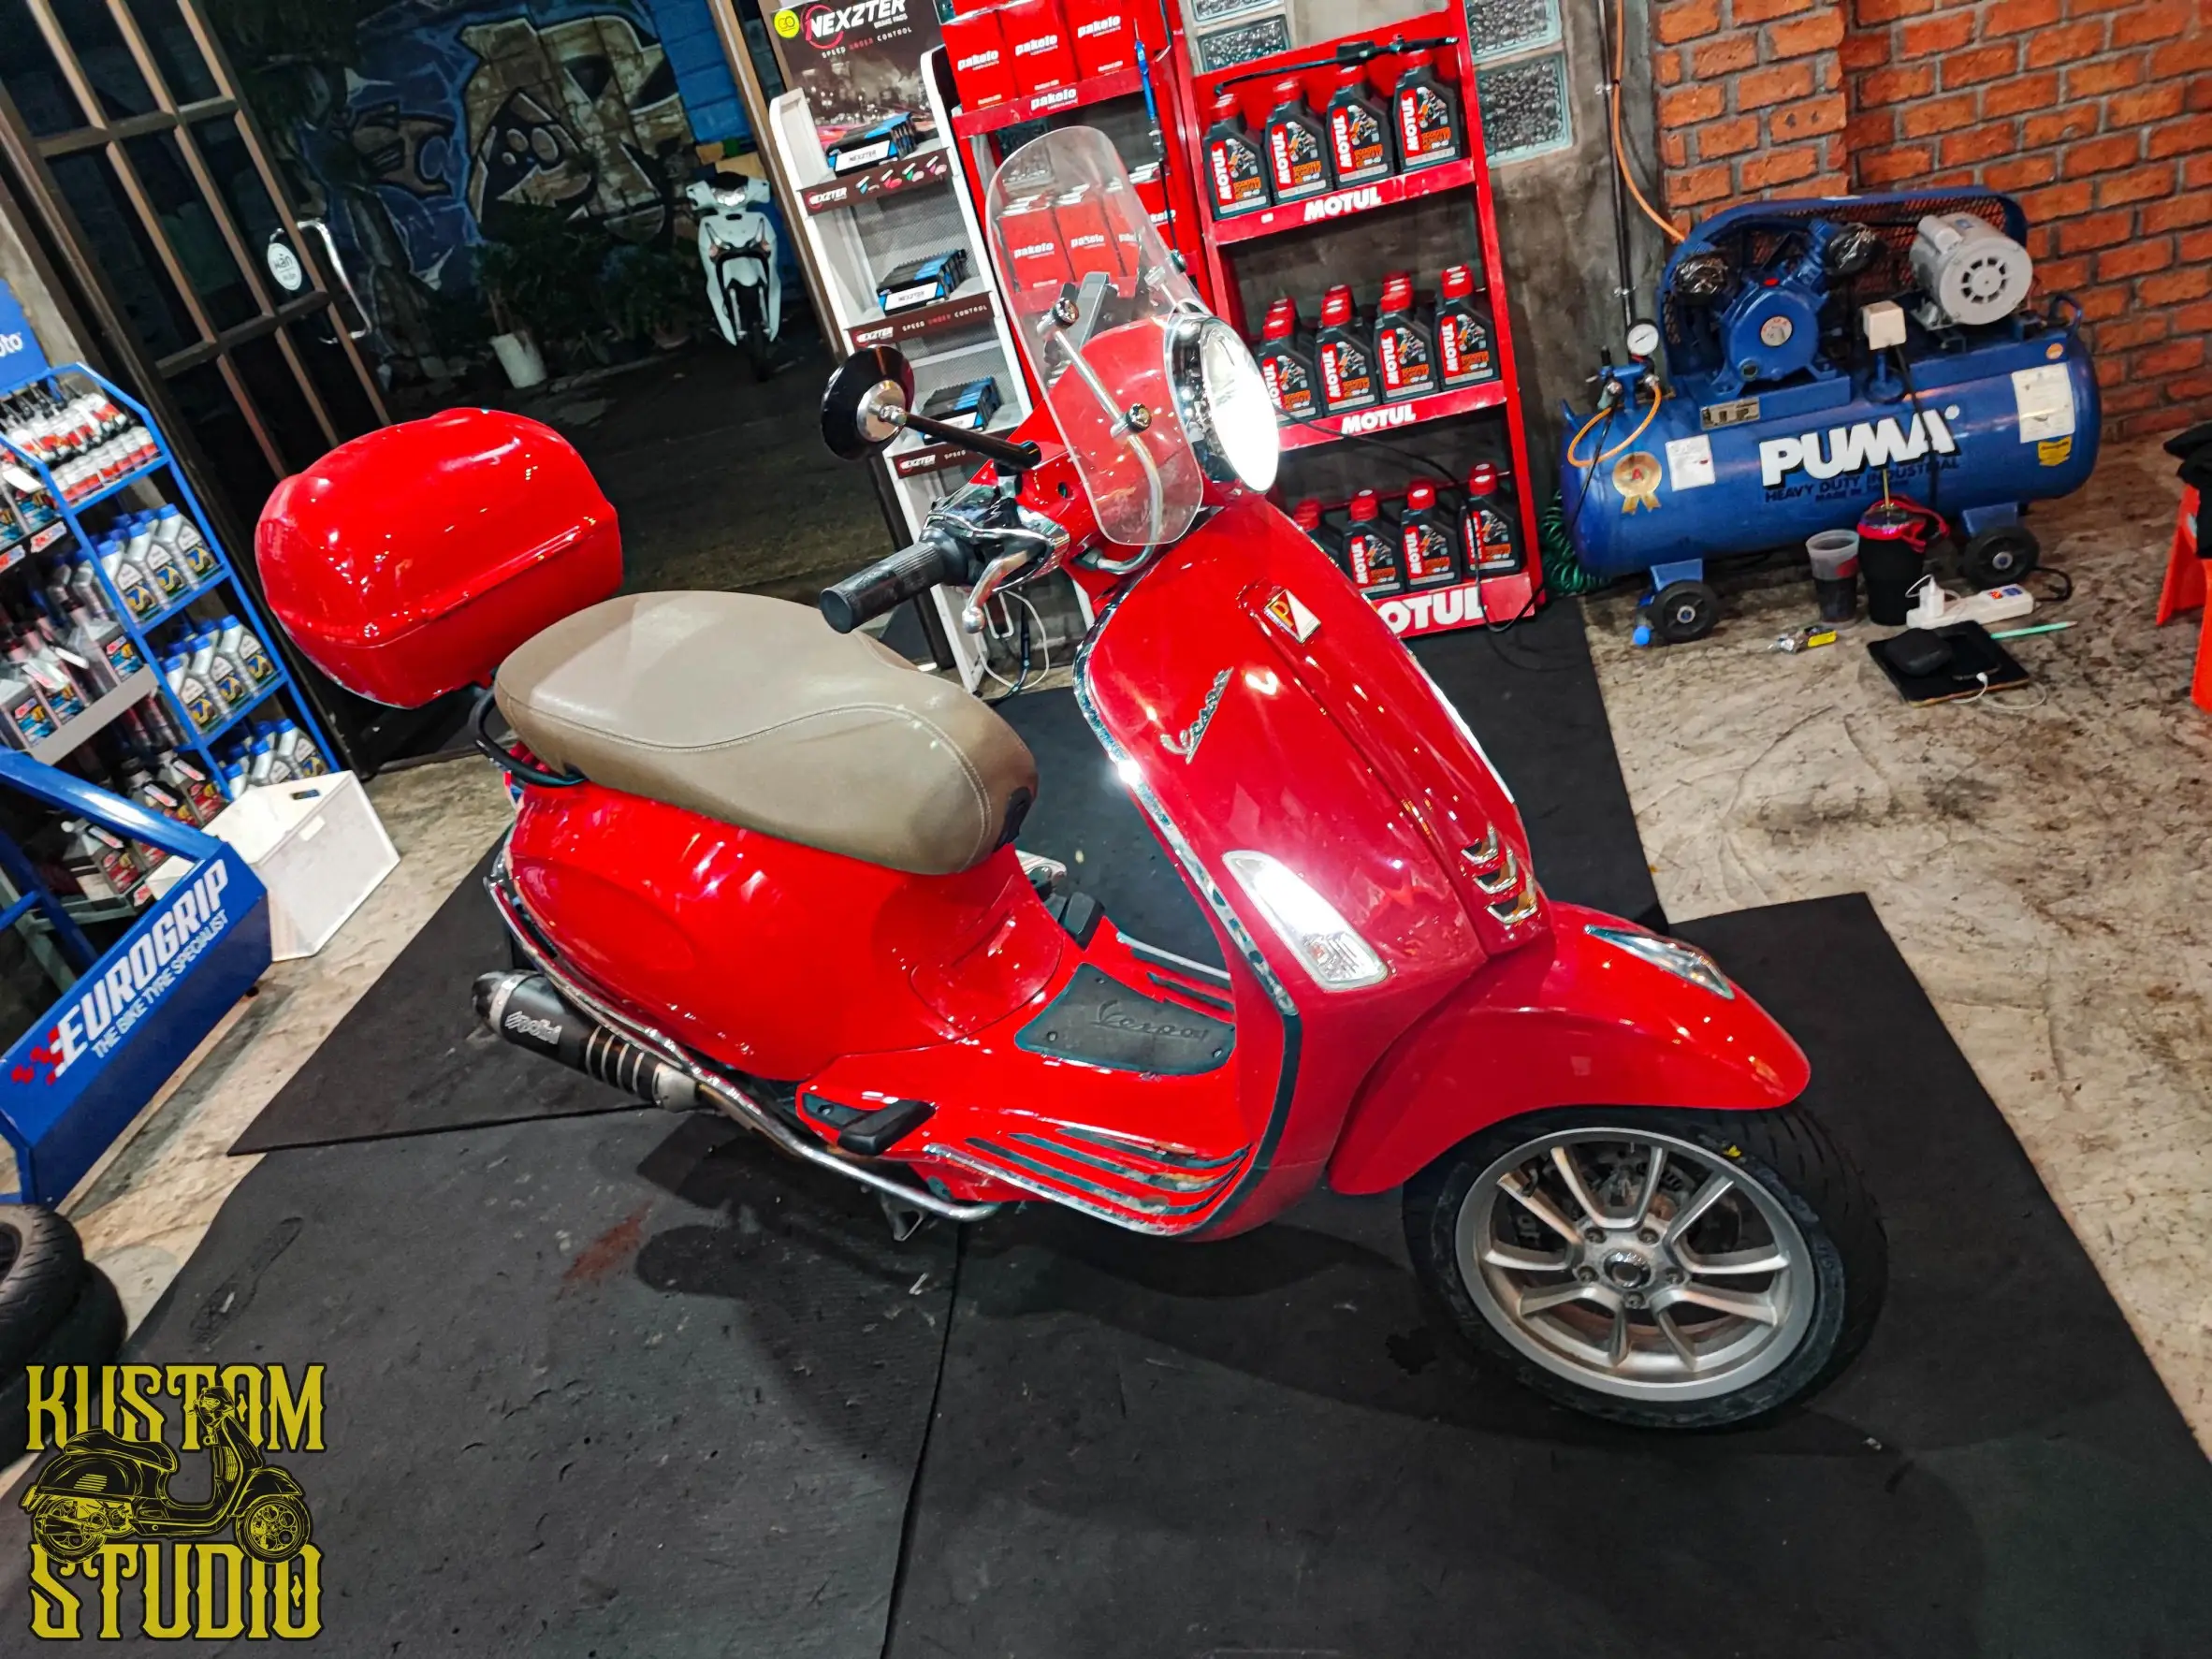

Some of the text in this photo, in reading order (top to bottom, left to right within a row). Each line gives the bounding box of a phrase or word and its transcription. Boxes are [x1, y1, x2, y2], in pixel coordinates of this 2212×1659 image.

[809, 0, 907, 37] NEXZTER
[1078, 15, 1121, 37] pakelo
[822, 46, 847, 59] SPEED
[877, 26, 912, 42] CONTROL
[957, 50, 999, 71] pakelo
[1015, 35, 1058, 56] pakelo
[1030, 88, 1077, 111] pakelo
[1332, 114, 1353, 167] MOTUL
[1401, 96, 1420, 151] MOTUL
[1211, 148, 1233, 200] MOTUL
[1271, 131, 1292, 184] MOTUL
[1303, 186, 1382, 222] MOTUL
[1013, 242, 1055, 259] pakelo
[902, 320, 925, 332] SPEED
[953, 304, 988, 318] CONTROL
[1380, 336, 1400, 385] MOTUL
[1441, 323, 1460, 372] MOTUL
[1321, 350, 1342, 398] MOTUL
[1341, 403, 1417, 435] MOTUL
[1759, 409, 1956, 488] PUMA
[1766, 483, 1814, 502] HEAVY
[1820, 475, 1861, 493] DUTY
[1867, 459, 1958, 486] INDUSTAL
[1350, 542, 1369, 585] MOTUL
[1404, 531, 1423, 575] MOTUL
[1376, 586, 1488, 634] OTUL
[1159, 665, 1235, 765] Vespa
[57, 858, 229, 1068] EUROGRIP
[92, 909, 229, 1059] THE BIKE TYRE SPECIALIST
